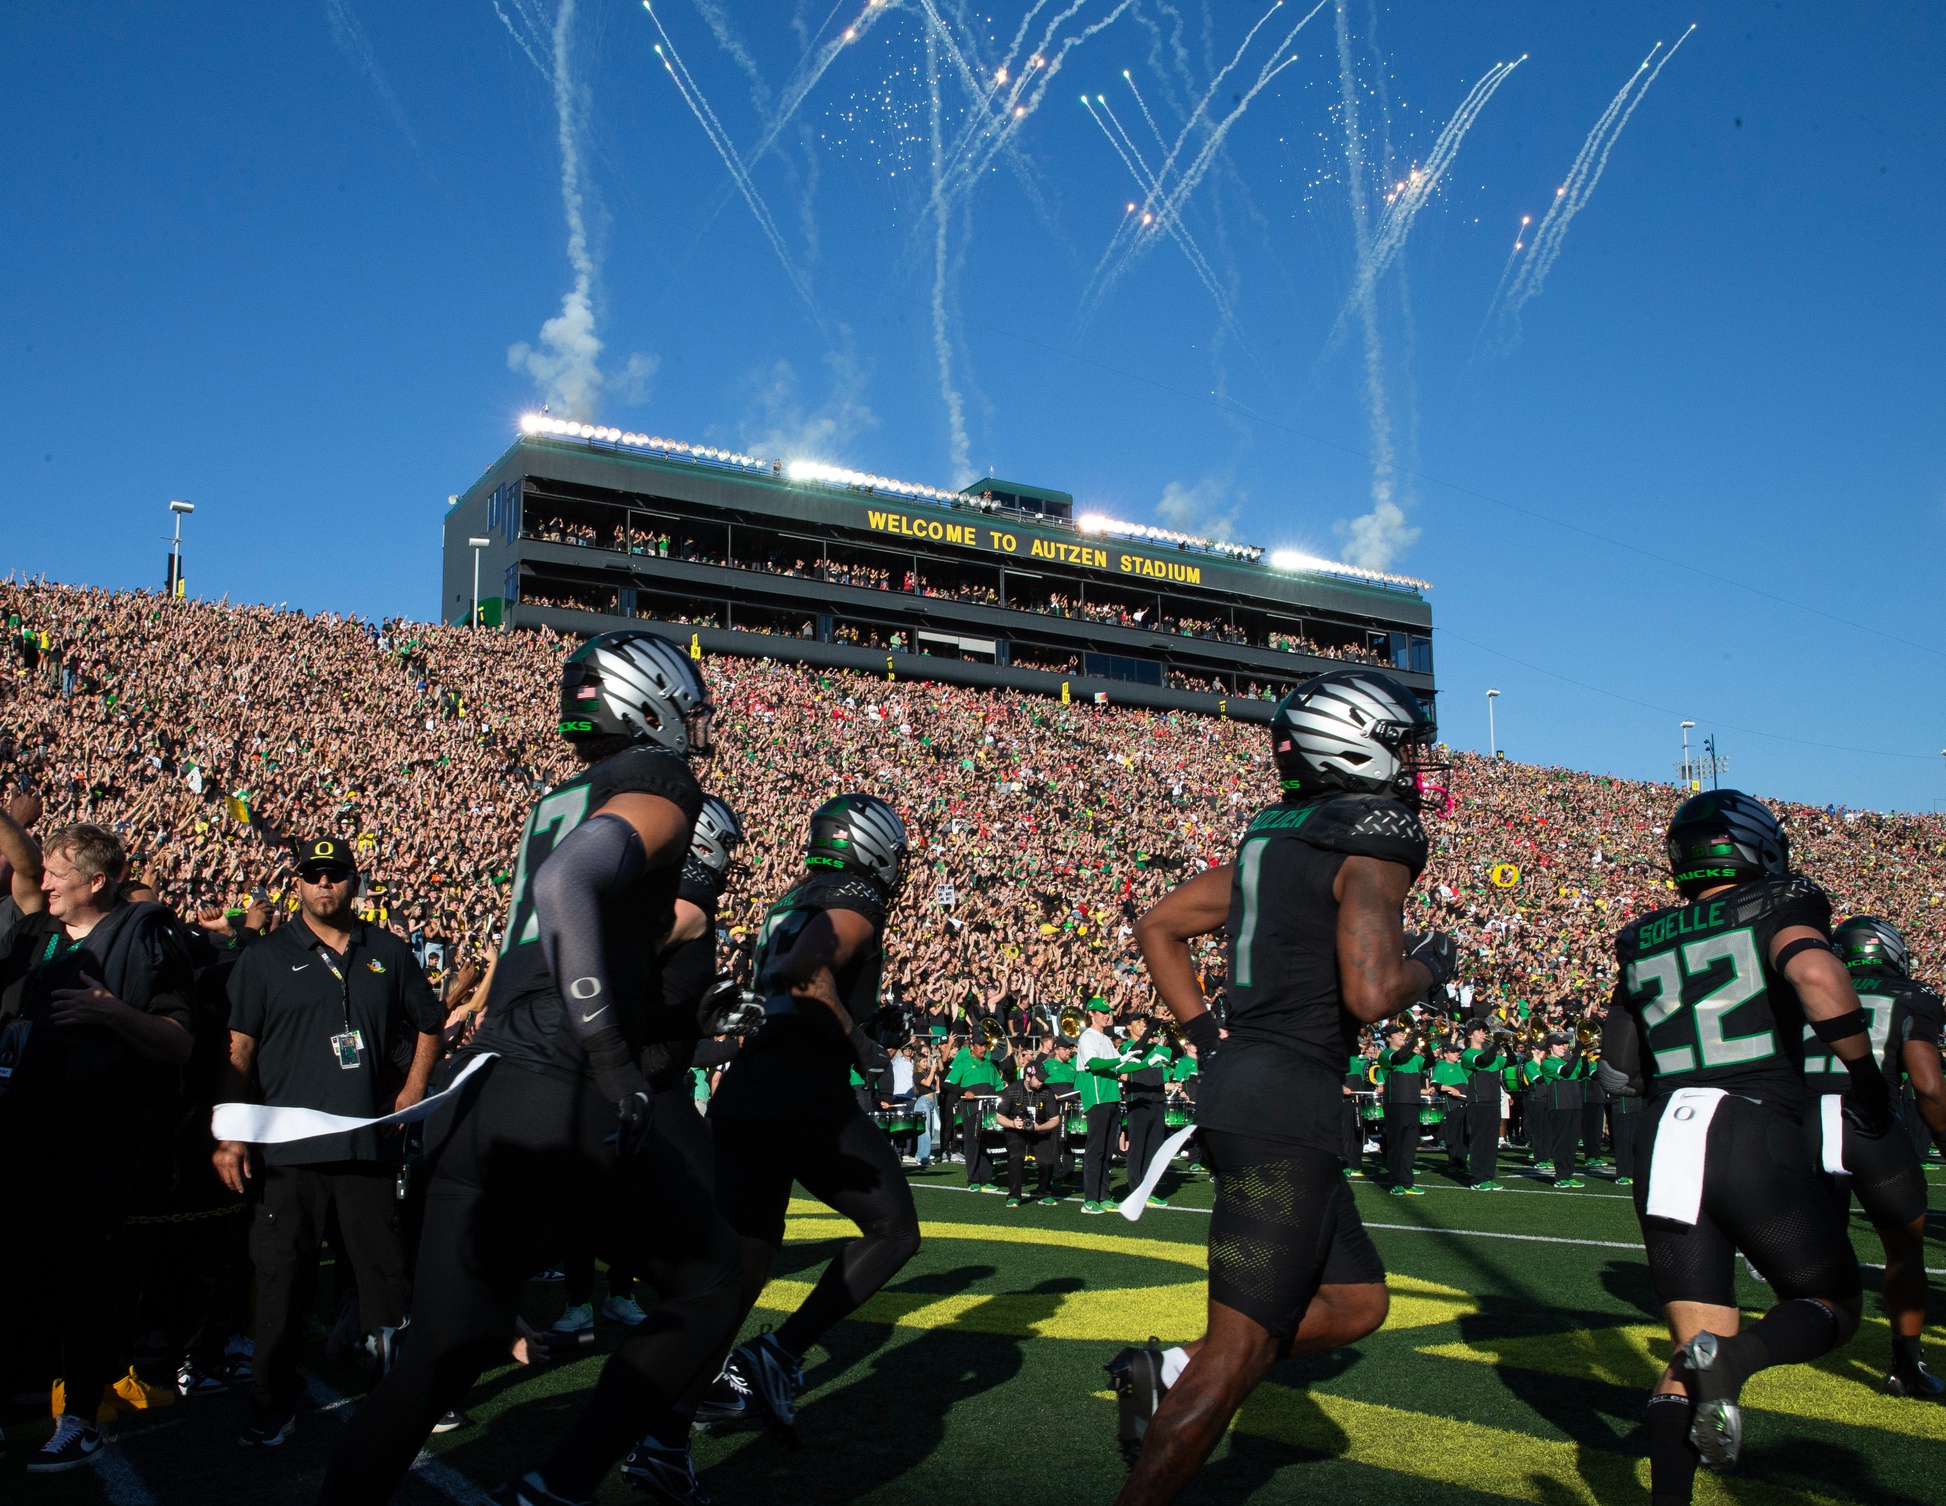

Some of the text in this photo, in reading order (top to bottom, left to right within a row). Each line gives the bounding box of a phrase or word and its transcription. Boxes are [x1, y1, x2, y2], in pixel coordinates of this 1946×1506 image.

[868, 510, 1201, 585] WELCOME TO AUTZEN STADIUM
[888, 672, 895, 680] 10
[558, 721, 592, 732] CKS
[315, 841, 335, 860] O
[805, 857, 845, 869] UCKS
[1675, 868, 1737, 883] DUCKS
[1235, 837, 1271, 988] 1
[1639, 901, 1727, 949] SOELLE
[570, 976, 602, 999] O
[1627, 925, 1777, 1078] 22
